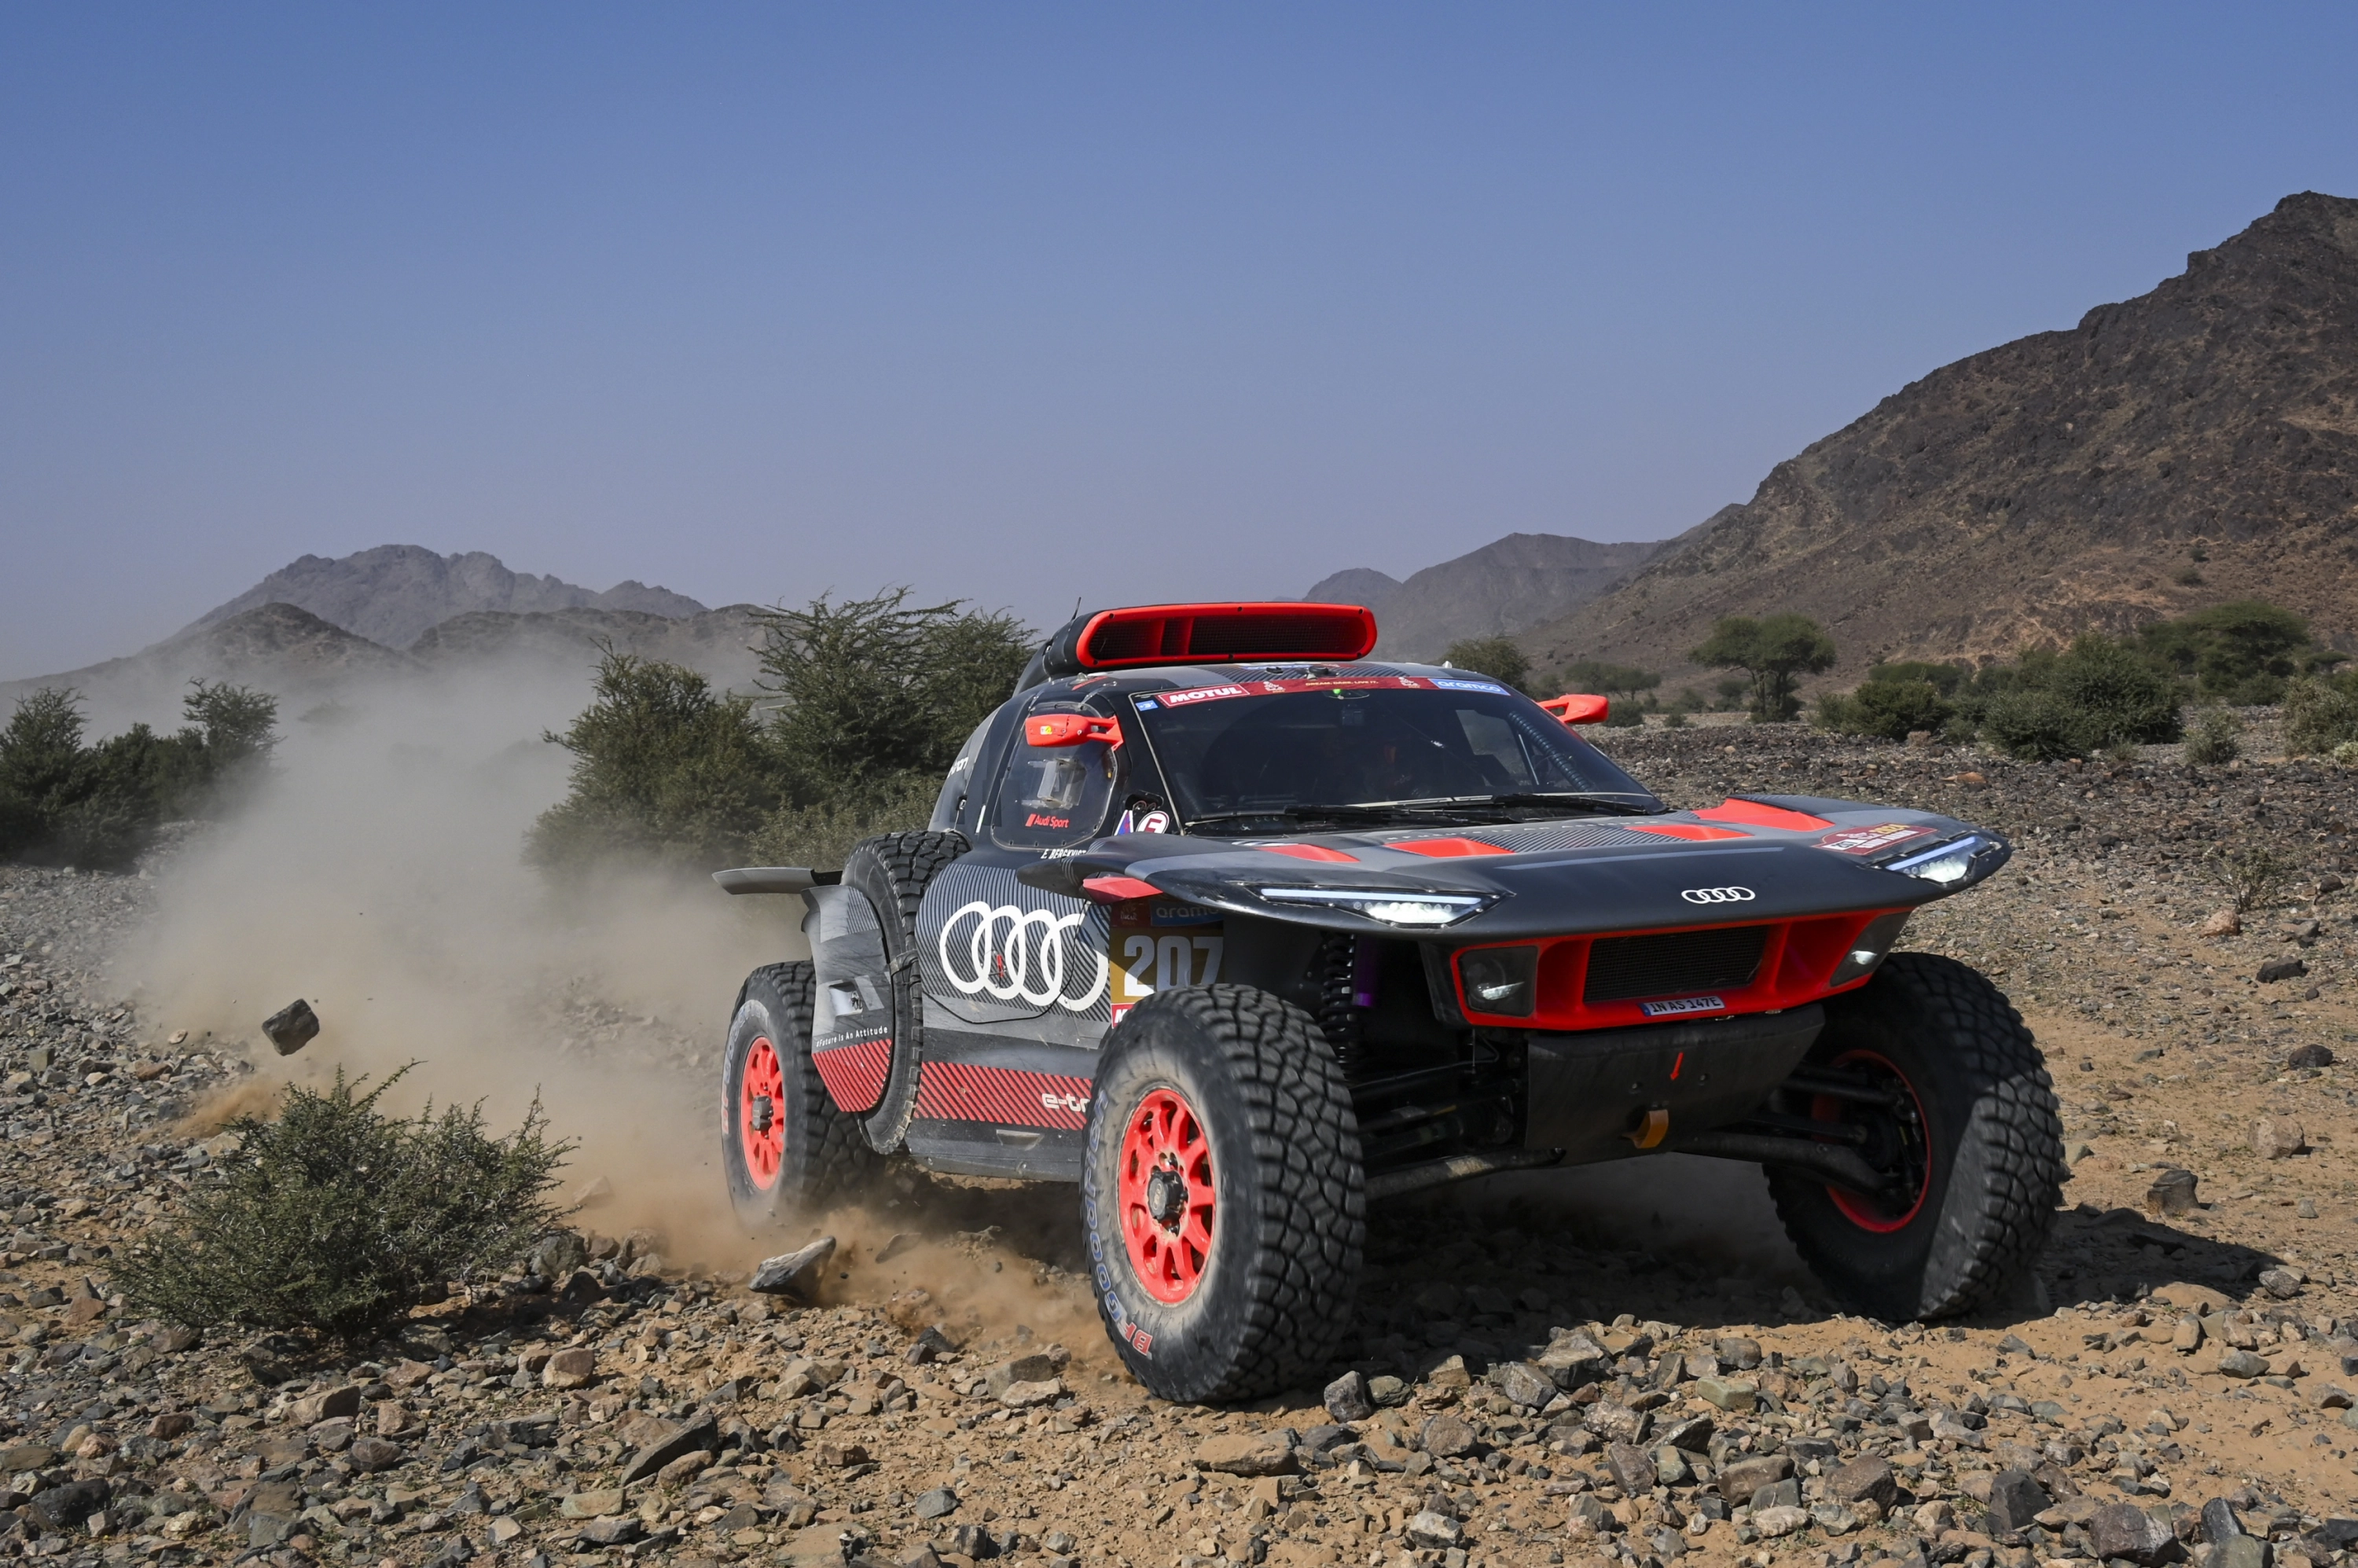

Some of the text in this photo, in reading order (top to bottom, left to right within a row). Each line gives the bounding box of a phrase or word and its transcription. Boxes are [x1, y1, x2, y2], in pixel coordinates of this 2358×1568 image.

[1437, 681, 1501, 693] aramco
[1169, 687, 1243, 704] MOTUL
[1034, 814, 1070, 829] Audi Sport
[1155, 906, 1219, 918] aramc
[1124, 935, 1224, 997] 207
[1668, 1000, 1686, 1012] AS
[1686, 997, 1721, 1009] 147E
[845, 1031, 854, 1040] An
[855, 1025, 888, 1038] Attitude
[1041, 1092, 1091, 1113] e-tr
